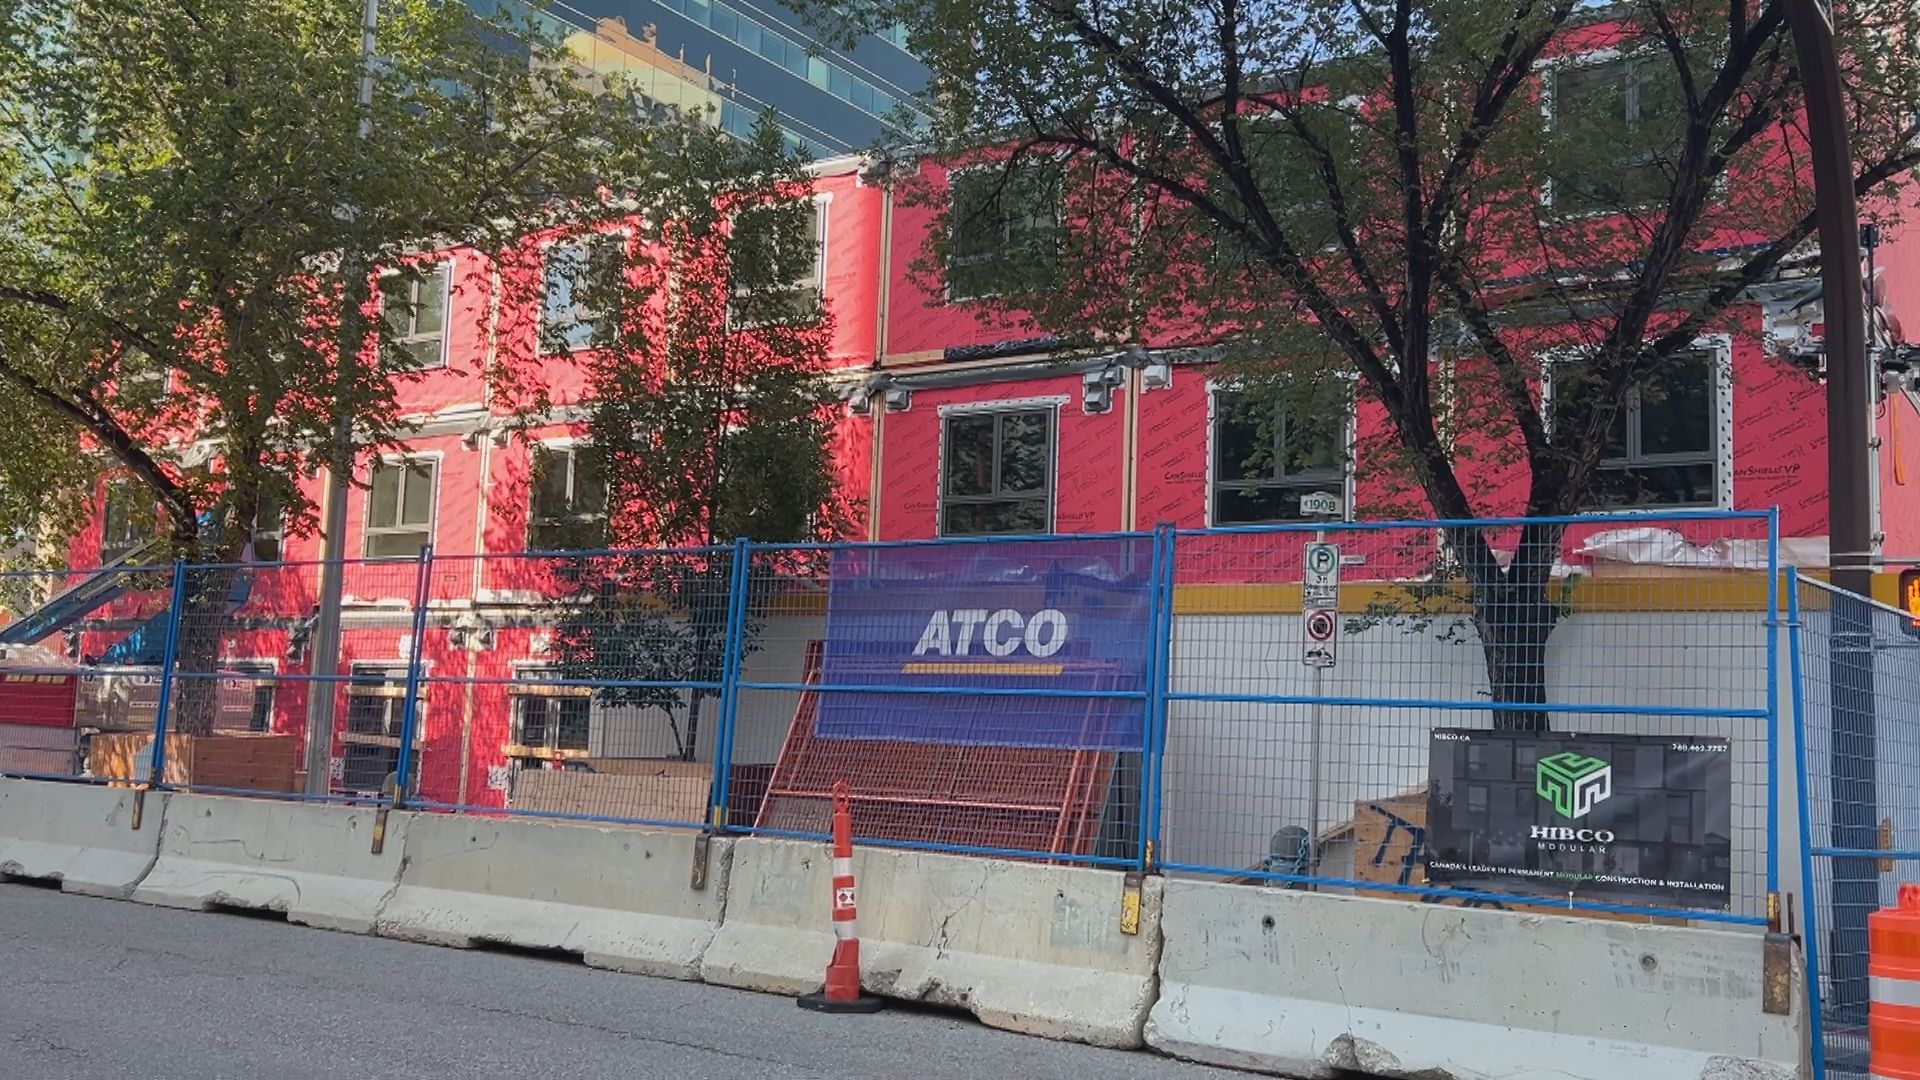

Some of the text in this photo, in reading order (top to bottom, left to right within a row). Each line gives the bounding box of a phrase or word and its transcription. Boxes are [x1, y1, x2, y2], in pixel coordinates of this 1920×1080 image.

[1316, 551, 1330, 568] P
[912, 608, 1069, 658] ATCO
[1529, 825, 1615, 843] HIBCO
[1537, 842, 1606, 854] MODULAR
[1508, 867, 1555, 878] PERMANENT
[1556, 871, 1593, 881] MODULAR
[1595, 874, 1657, 886] CONSTRUCTION
[1667, 880, 1725, 891] INSTALLATION
